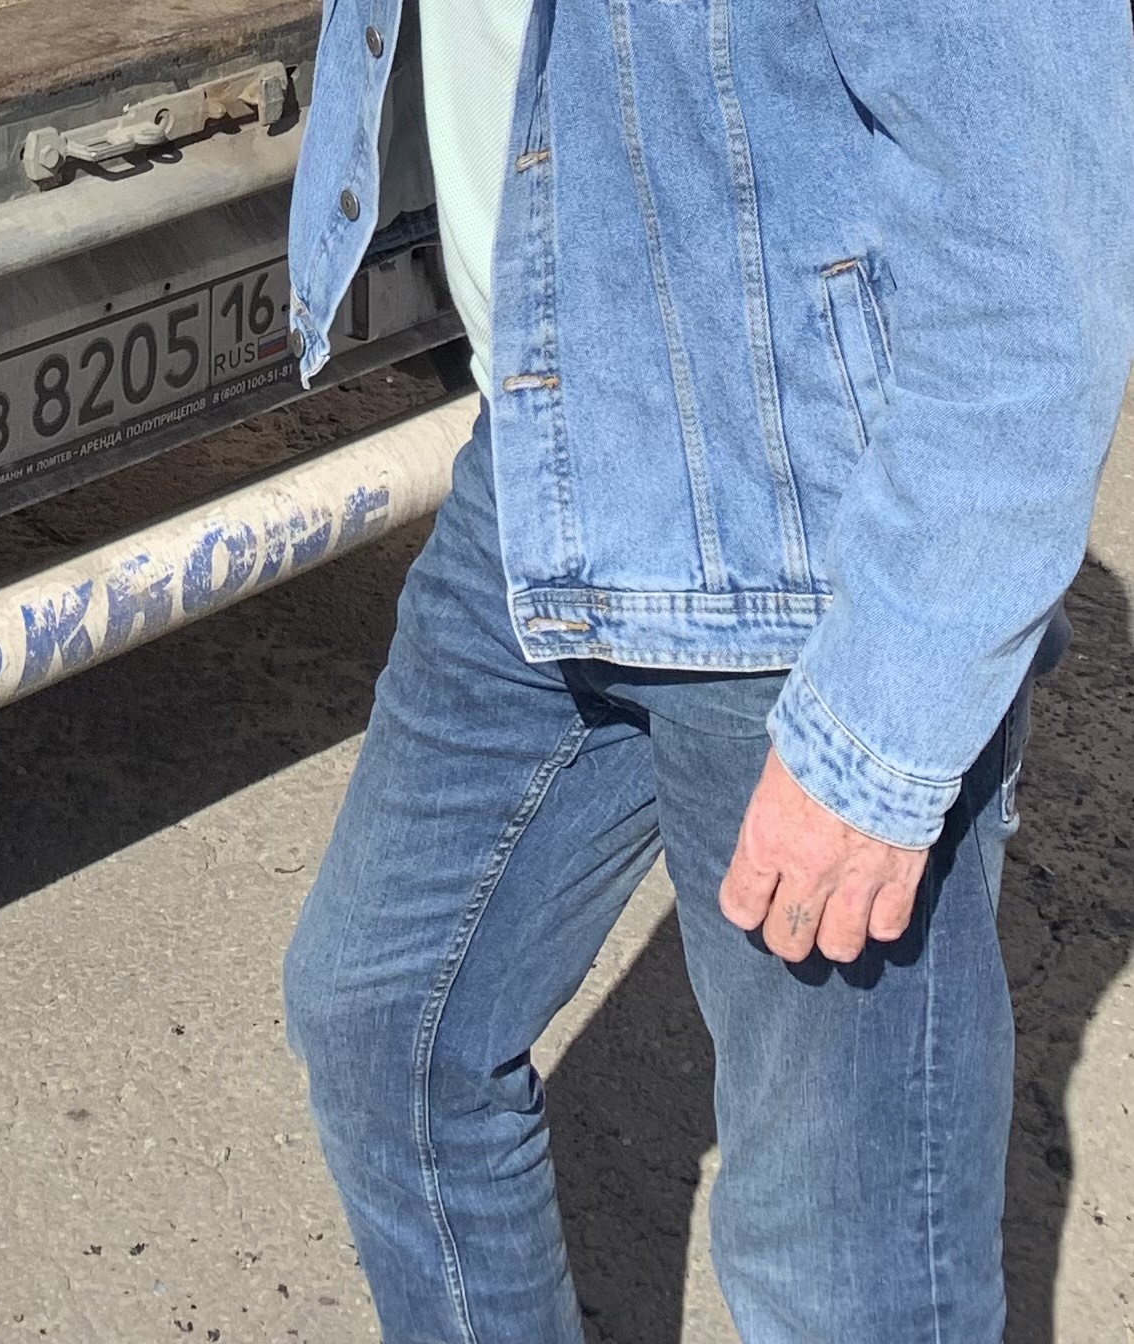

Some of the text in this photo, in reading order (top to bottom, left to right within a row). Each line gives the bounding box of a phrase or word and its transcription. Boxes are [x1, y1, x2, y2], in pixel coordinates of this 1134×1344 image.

[32, 301, 200, 438] 8205
[220, 271, 275, 344] 16
[213, 342, 256, 376] RUS
[125, 397, 207, 439] ПОЛУПРИЦЕПОВ
